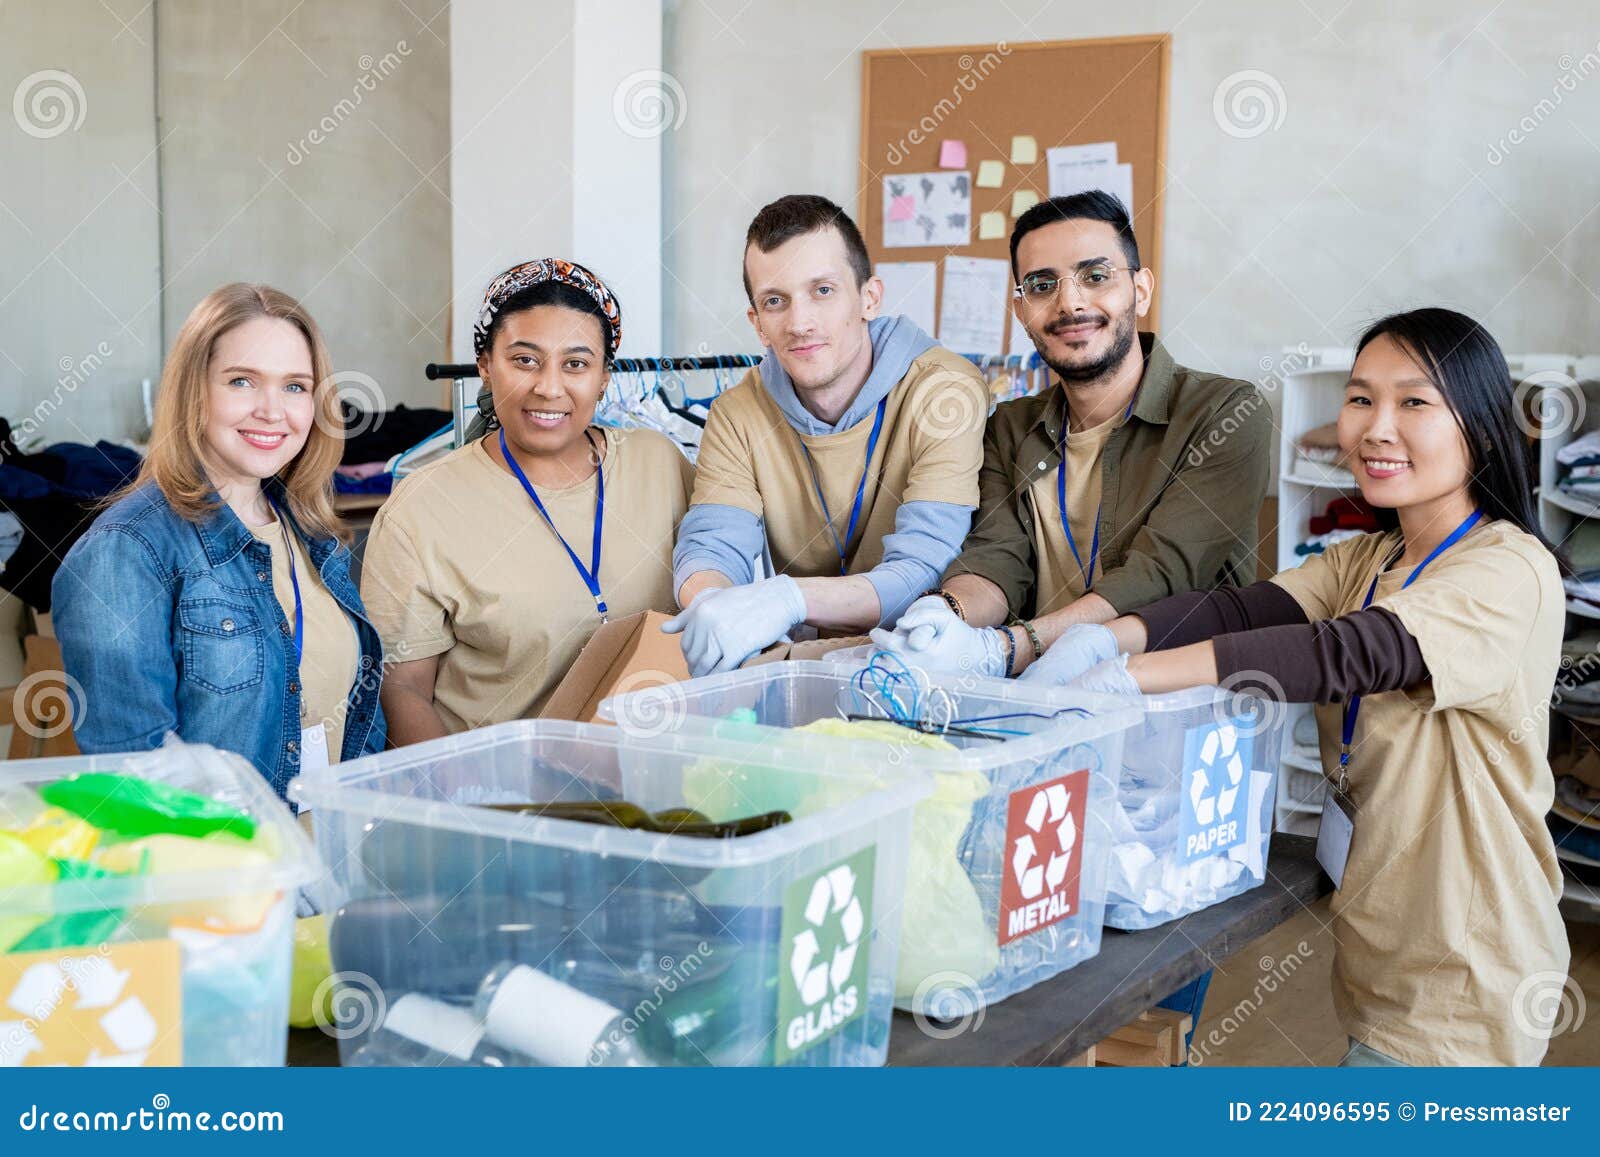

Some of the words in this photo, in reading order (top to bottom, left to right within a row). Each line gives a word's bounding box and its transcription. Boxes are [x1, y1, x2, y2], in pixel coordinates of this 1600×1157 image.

[1186, 820, 1237, 858] PAPER
[1008, 890, 1070, 937] METAL
[787, 984, 858, 1051] GLASS
